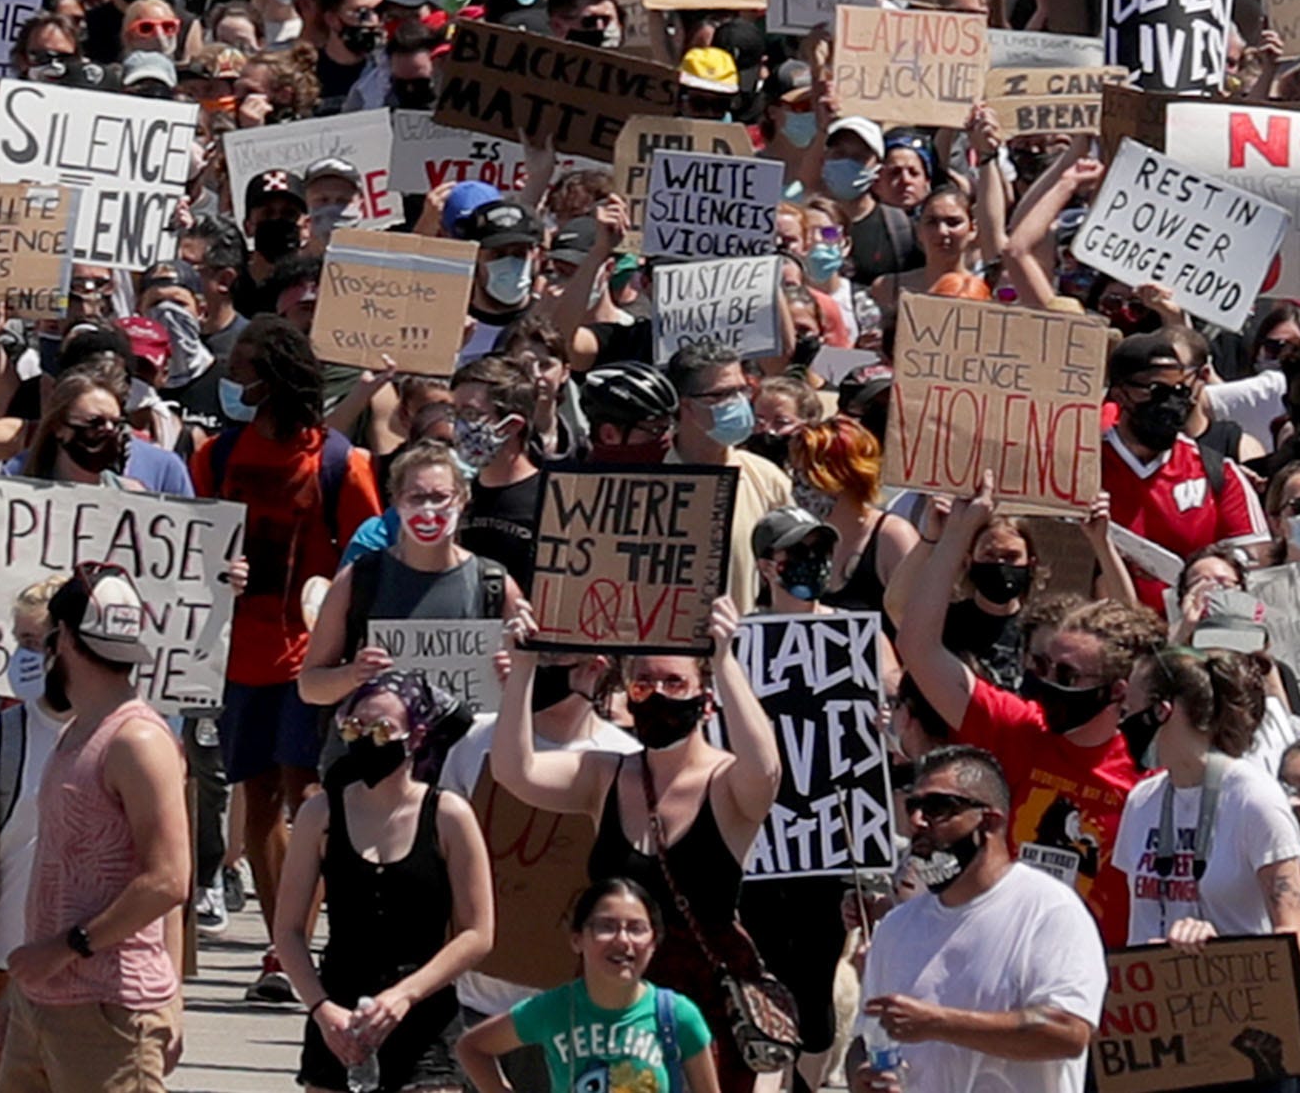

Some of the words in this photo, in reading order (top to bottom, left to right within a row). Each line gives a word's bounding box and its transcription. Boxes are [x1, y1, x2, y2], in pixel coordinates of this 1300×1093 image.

[842, 9, 982, 55] LATINOS
[1108, 17, 1227, 90] LIVES
[837, 65, 936, 100] BLACK
[0, 85, 197, 185] SILENCE
[470, 142, 501, 160] IS
[663, 159, 757, 199] WHITE
[1134, 156, 1225, 205] REST
[1231, 195, 1259, 227] IN
[657, 229, 772, 256] VIOLENCE
[1108, 193, 1232, 264] POWER
[326, 260, 439, 304] Prosecute
[661, 260, 768, 305] JUSTICE
[1083, 226, 1174, 287] GEORGE
[1173, 260, 1243, 313] FLOYD
[360, 297, 397, 321] the
[660, 301, 724, 337] MUST
[727, 296, 761, 327] BE
[902, 300, 1097, 371] WHITE
[904, 348, 1031, 388] SILENCE
[1058, 366, 1092, 397] IS
[895, 381, 1099, 508] VIOLENCE
[551, 476, 695, 538] WHERE
[534, 535, 596, 576] IS
[616, 541, 697, 585] THE
[411, 630, 489, 656] JUSTICE
[1159, 951, 1281, 991] JUSTICE
[1167, 986, 1269, 1031] PEACE
[1102, 1034, 1186, 1078] BLM
